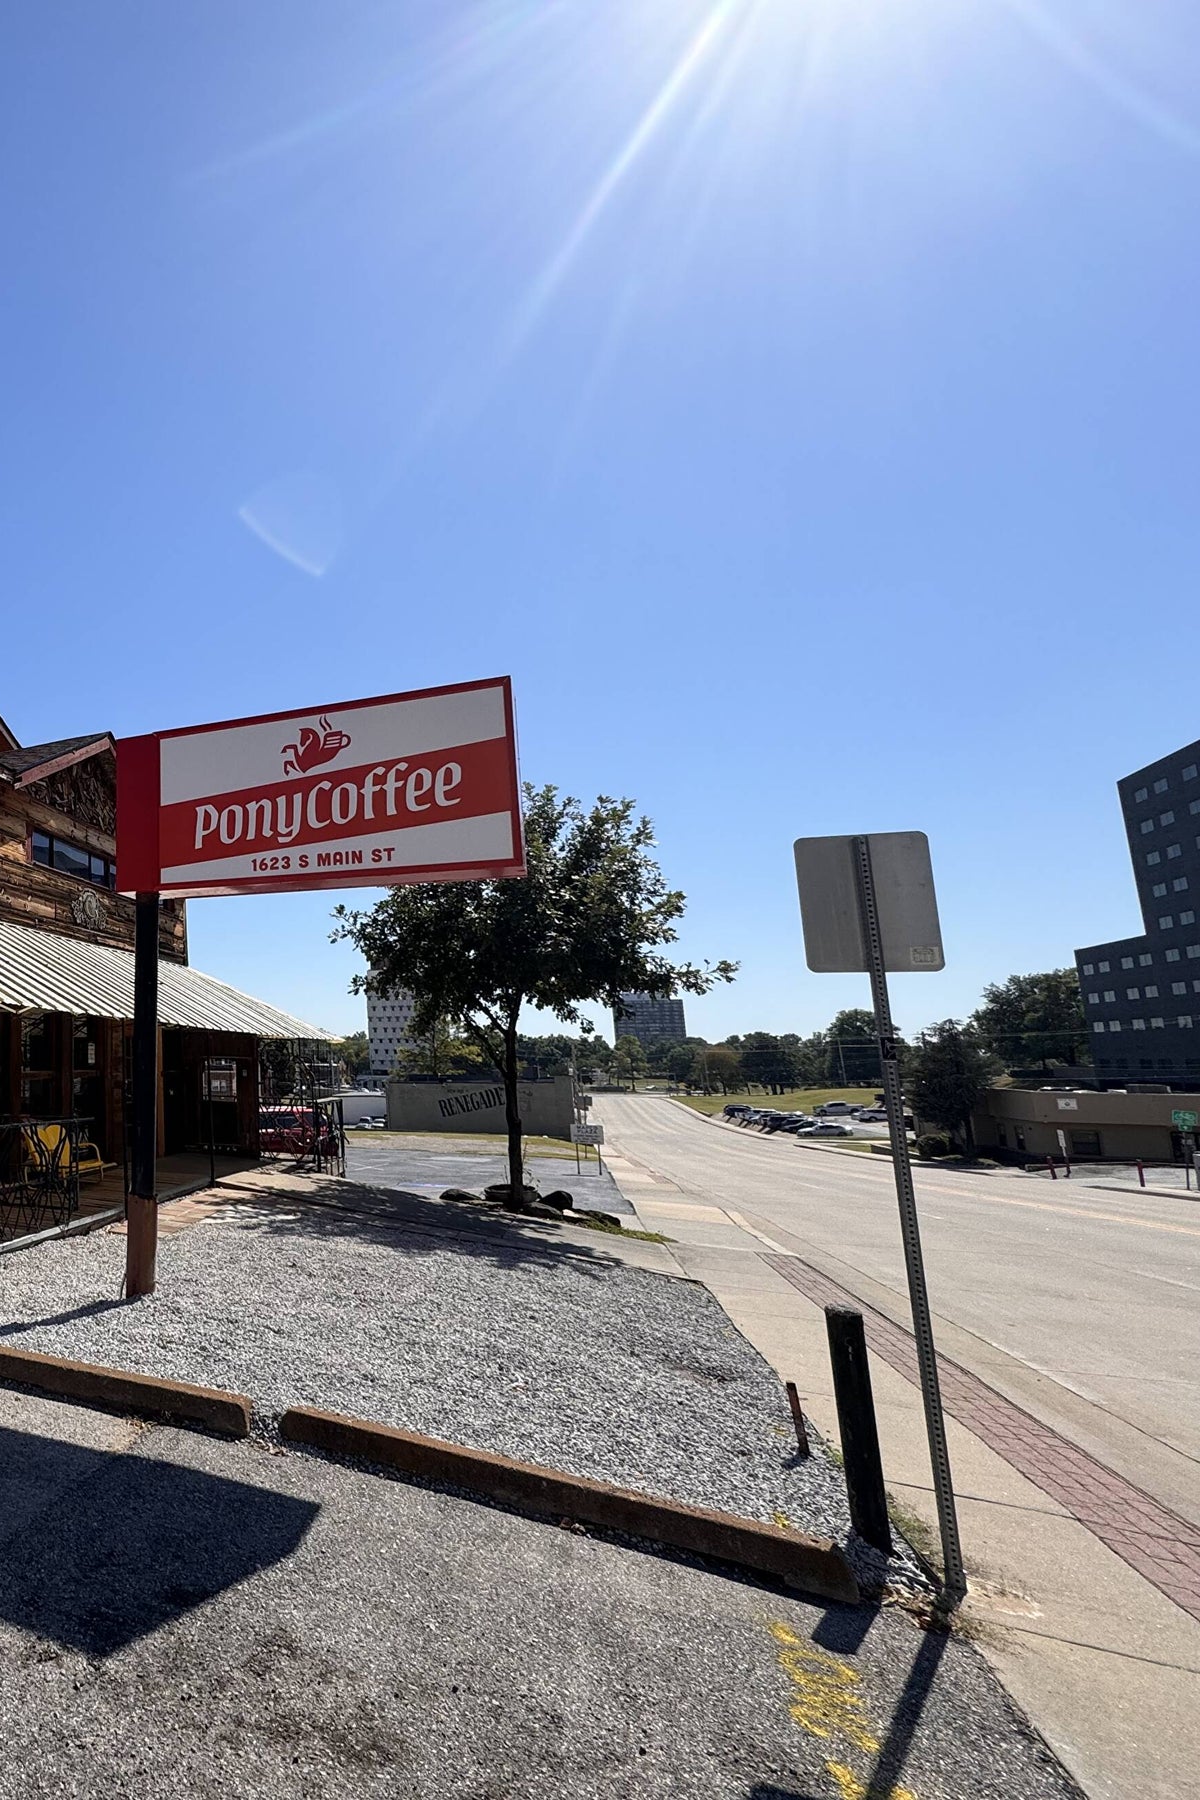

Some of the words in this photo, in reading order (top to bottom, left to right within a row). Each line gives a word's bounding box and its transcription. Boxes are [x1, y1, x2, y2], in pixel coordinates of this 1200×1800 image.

[251, 856, 291, 872] 1623
[299, 854, 309, 869] S
[316, 850, 363, 867] MAIN
[371, 847, 395, 863] ST
[439, 1087, 505, 1118] RENEGADE
